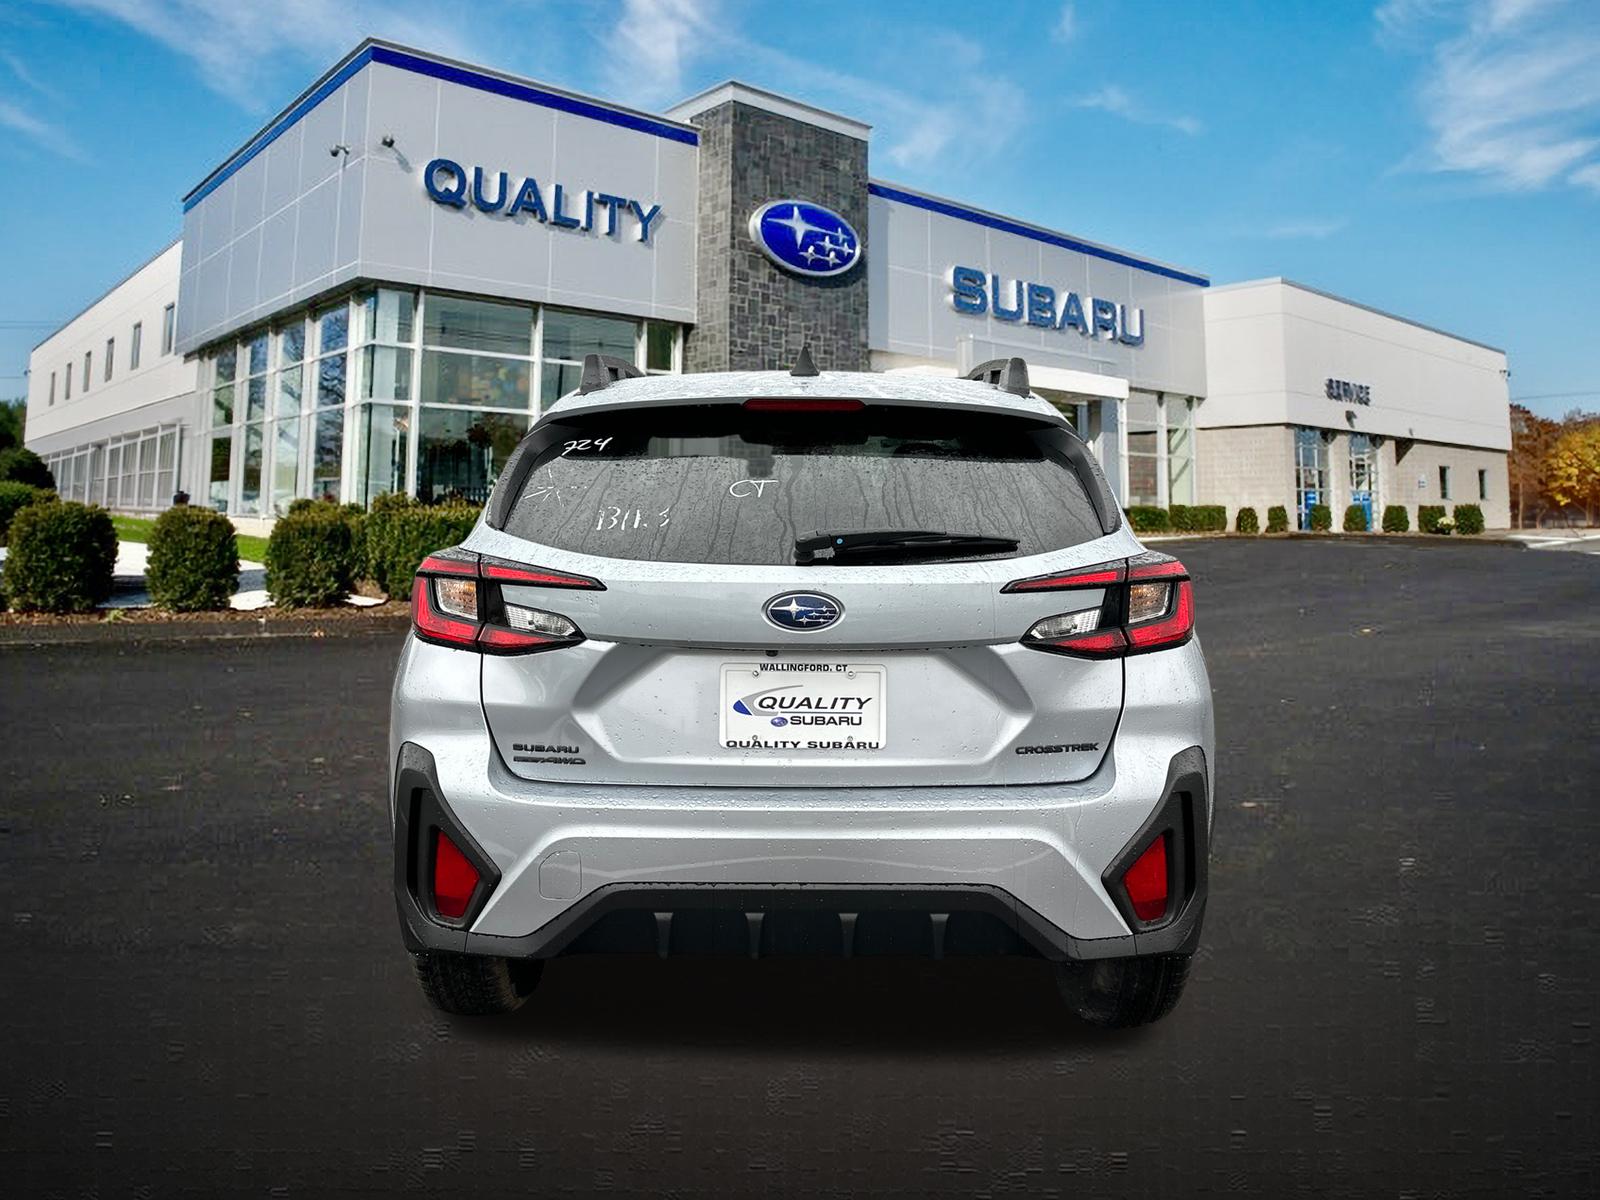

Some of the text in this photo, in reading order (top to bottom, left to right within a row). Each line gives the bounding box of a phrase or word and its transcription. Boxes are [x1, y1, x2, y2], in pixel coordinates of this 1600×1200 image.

[424, 158, 661, 243] QUALITY
[951, 265, 1145, 346] SUBARU
[836, 664, 848, 672] CT
[758, 696, 872, 710] QUALITY
[790, 716, 862, 726] SUBARU
[513, 744, 579, 754] SUBARU
[726, 740, 879, 749] QUALITY SUBARU
[1015, 742, 1099, 755] CROSSTREK
